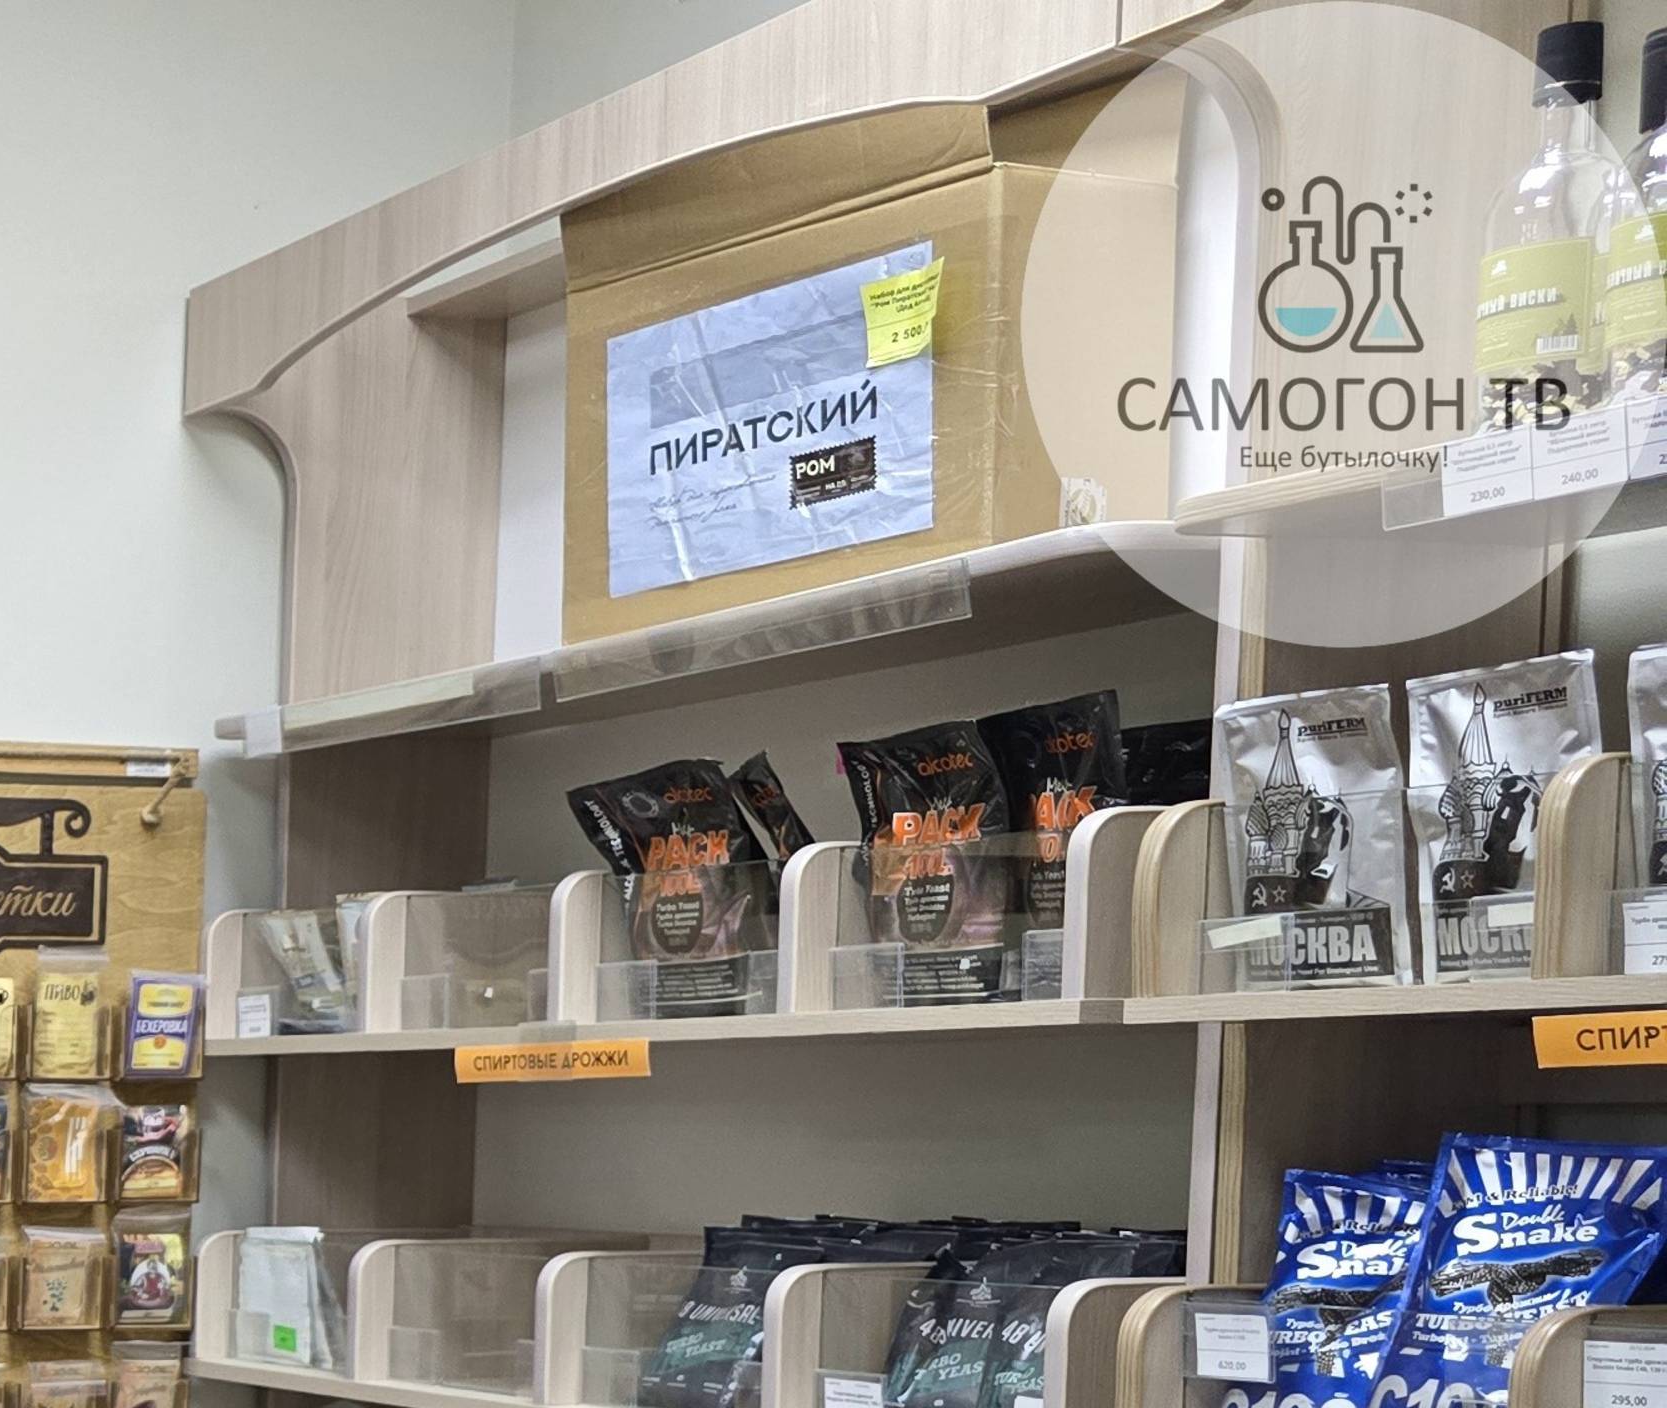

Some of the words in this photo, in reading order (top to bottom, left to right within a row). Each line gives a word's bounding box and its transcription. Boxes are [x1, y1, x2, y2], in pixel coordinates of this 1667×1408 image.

[649, 380, 879, 476] ПИРАТСКИЙ
[795, 455, 835, 480] РОМ
[1562, 468, 1599, 485] 240,00
[1470, 486, 1505, 503] 230,00
[893, 803, 986, 848] PACK
[1436, 914, 1531, 956] МОСК
[1576, 1025, 1667, 1051] СПИР
[473, 1052, 557, 1072] СПИРТОВЫЕ
[562, 1049, 630, 1069] ДРОЖЖИ
[1453, 1212, 1599, 1256] Snake
[938, 1360, 984, 1380] YEAS
[1611, 1394, 1648, 1407] 295,00
